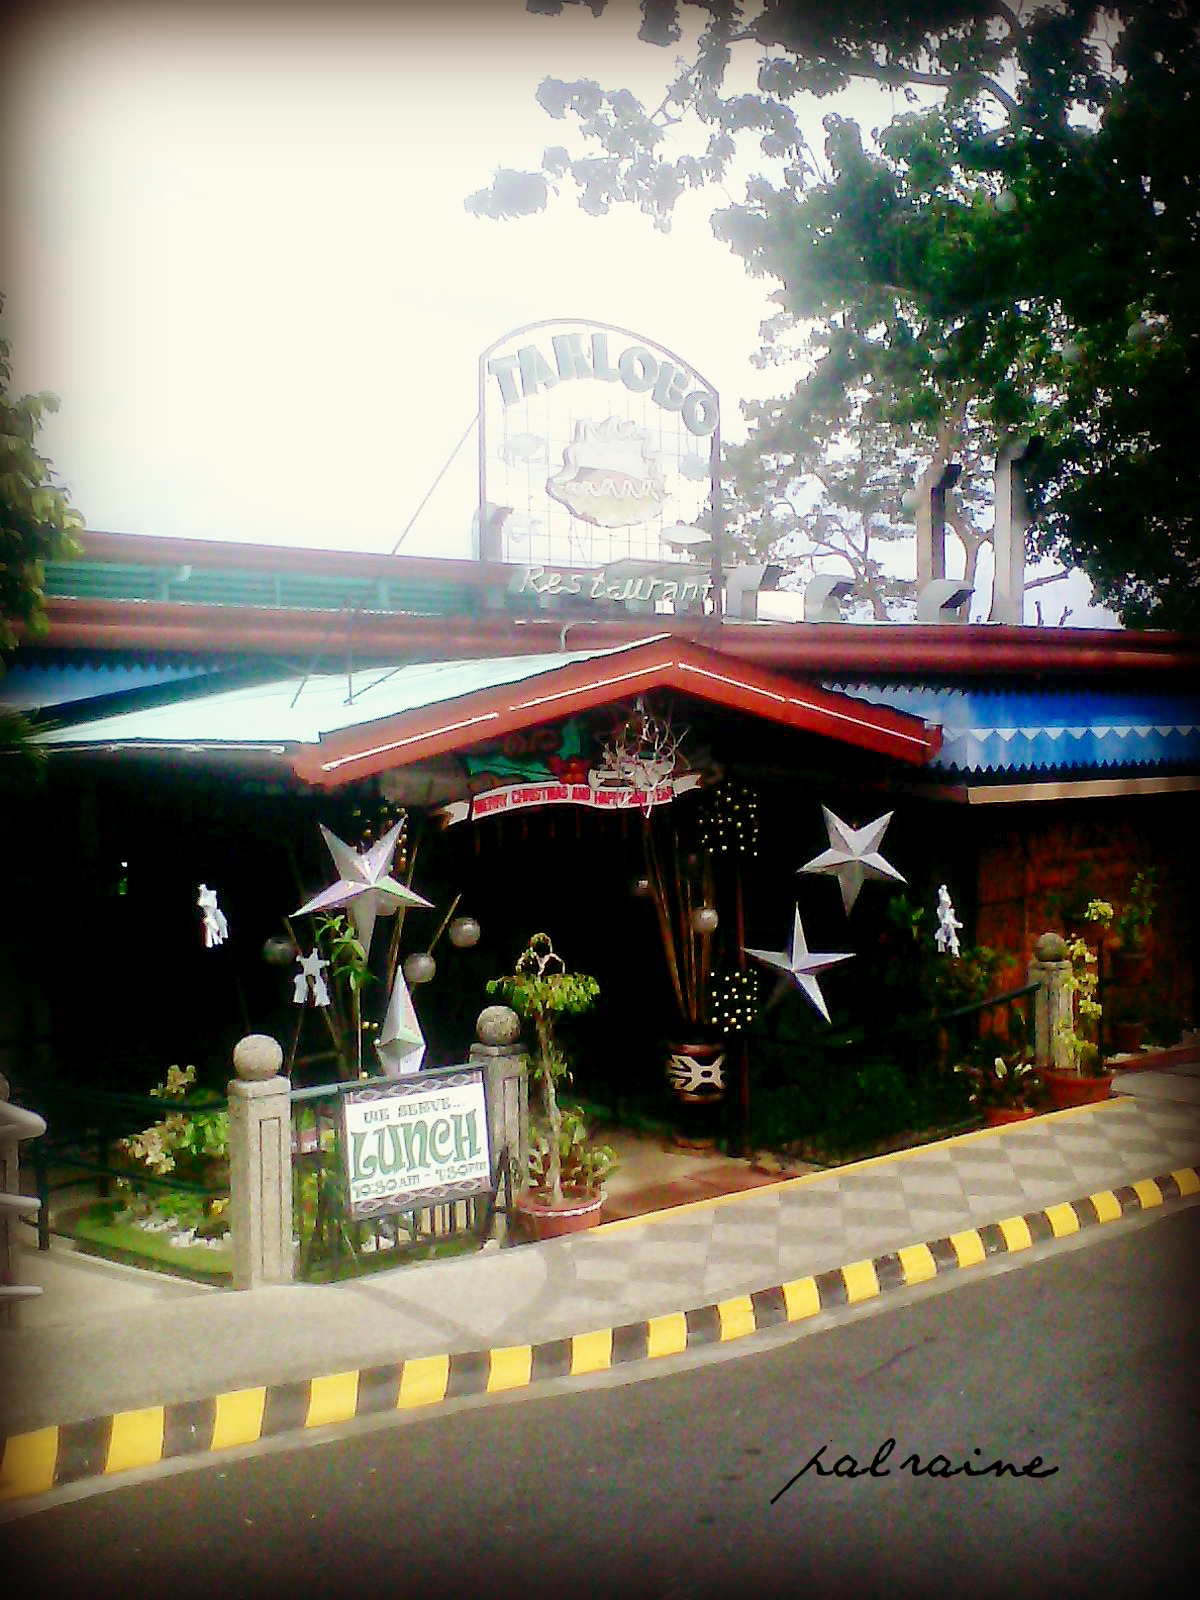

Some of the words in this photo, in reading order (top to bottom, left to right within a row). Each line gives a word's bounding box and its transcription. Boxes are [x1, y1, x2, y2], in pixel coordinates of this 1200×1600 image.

[488, 333, 719, 436] TAKLOBO
[519, 566, 714, 601] Restaurant
[364, 1108, 390, 1124] WE
